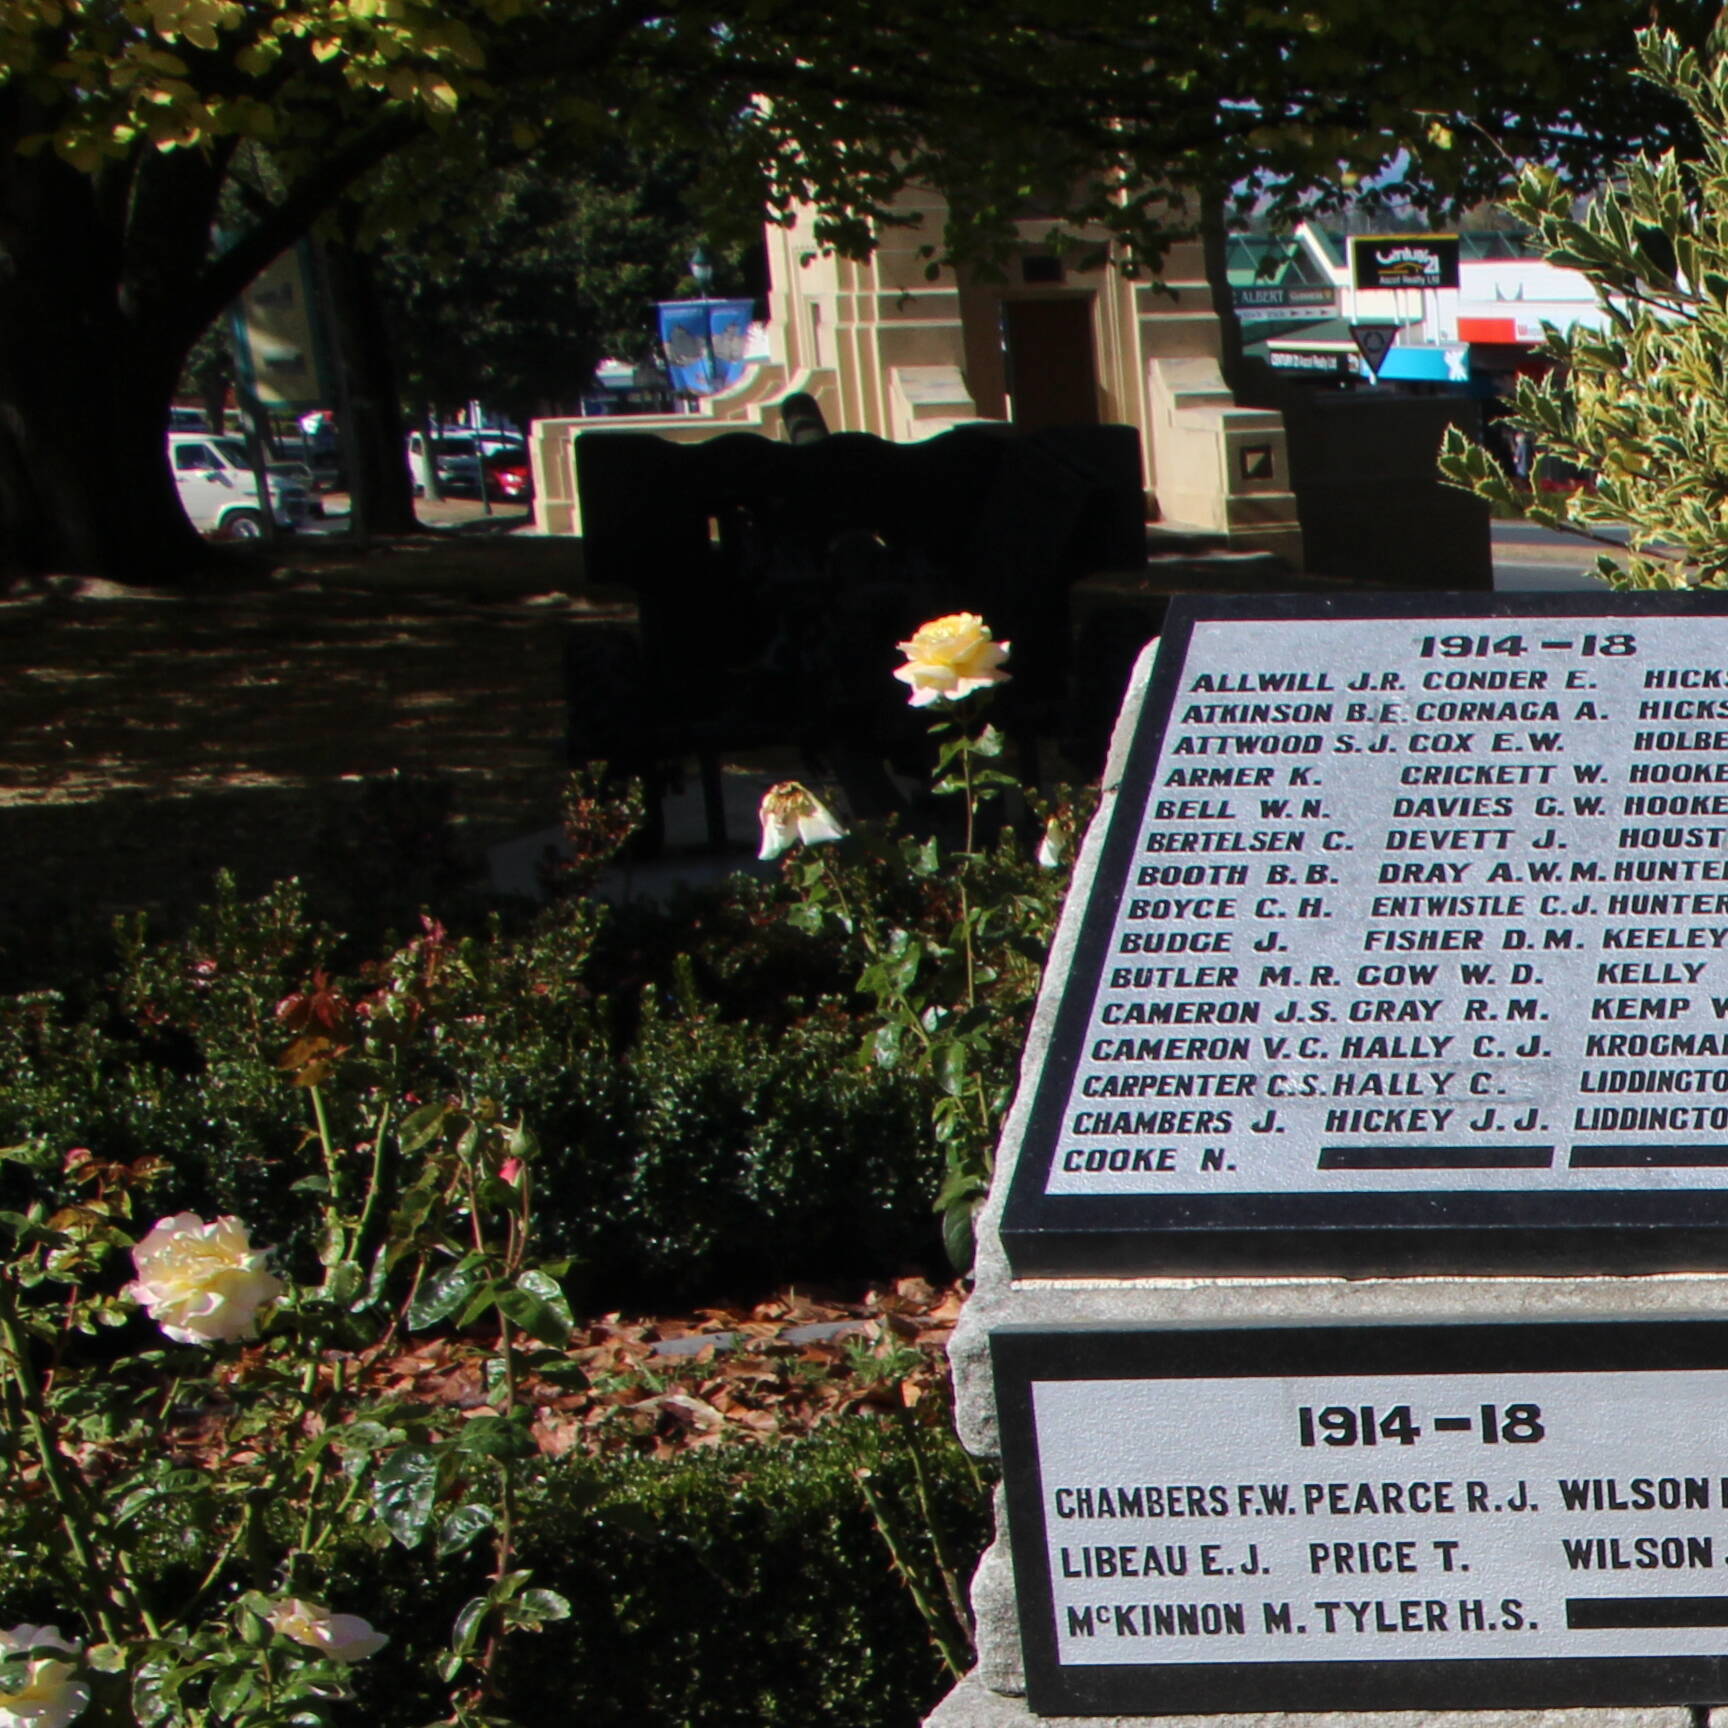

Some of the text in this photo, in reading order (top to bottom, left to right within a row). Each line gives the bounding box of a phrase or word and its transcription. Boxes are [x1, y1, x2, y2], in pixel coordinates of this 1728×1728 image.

[1189, 672, 1334, 692] ALLWILL
[1422, 671, 1597, 690] CONDER E.
[1182, 703, 1333, 723] ATKINSON
[1164, 768, 1321, 787] ARMER K.
[1146, 832, 1354, 852] BERTELSEN C.
[1371, 896, 1524, 918] ENTWISTLE
[1254, 932, 1288, 952] J.
[1101, 1002, 1260, 1025] CAMERON
[1082, 1075, 1257, 1097] CARPENTER
[1073, 1111, 1285, 1134] CHAMBERS J.
[1063, 1149, 1236, 1171] COOKE N.
[1055, 1485, 1297, 1520] CHAMBERS F.W.
[1305, 1480, 1539, 1516] PEARCE R.J.
[1559, 1477, 1710, 1511] WILSON
[1061, 1544, 1270, 1579] LIBEAU E.J.
[1310, 1541, 1470, 1574] PRICE T.
[1564, 1538, 1713, 1570] WILSON
[1264, 1601, 1306, 1634] M.
[1315, 1599, 1539, 1633] TYLER H.S.
